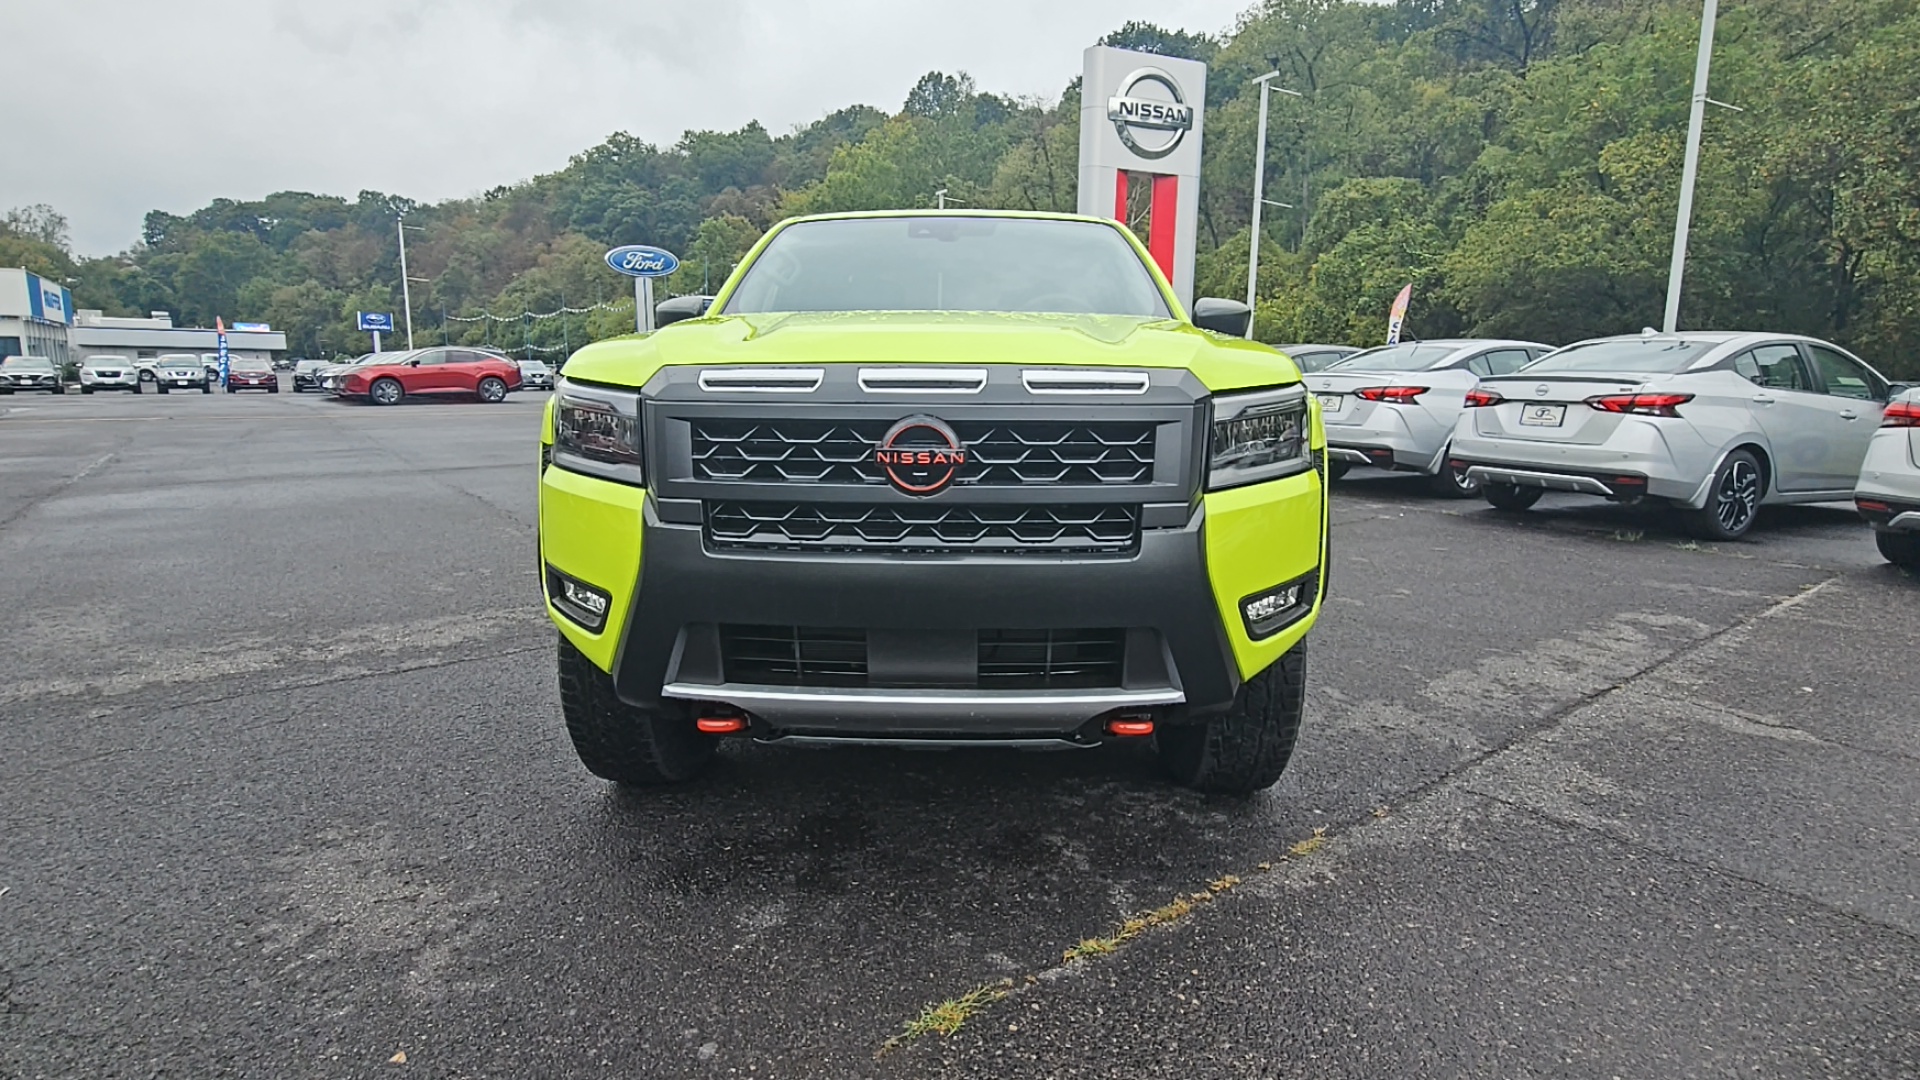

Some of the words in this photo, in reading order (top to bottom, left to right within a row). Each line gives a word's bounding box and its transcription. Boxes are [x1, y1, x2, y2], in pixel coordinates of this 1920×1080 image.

[1119, 101, 1187, 123] NISSAN
[623, 251, 664, 271] Ford
[876, 452, 964, 464] NISSAN
